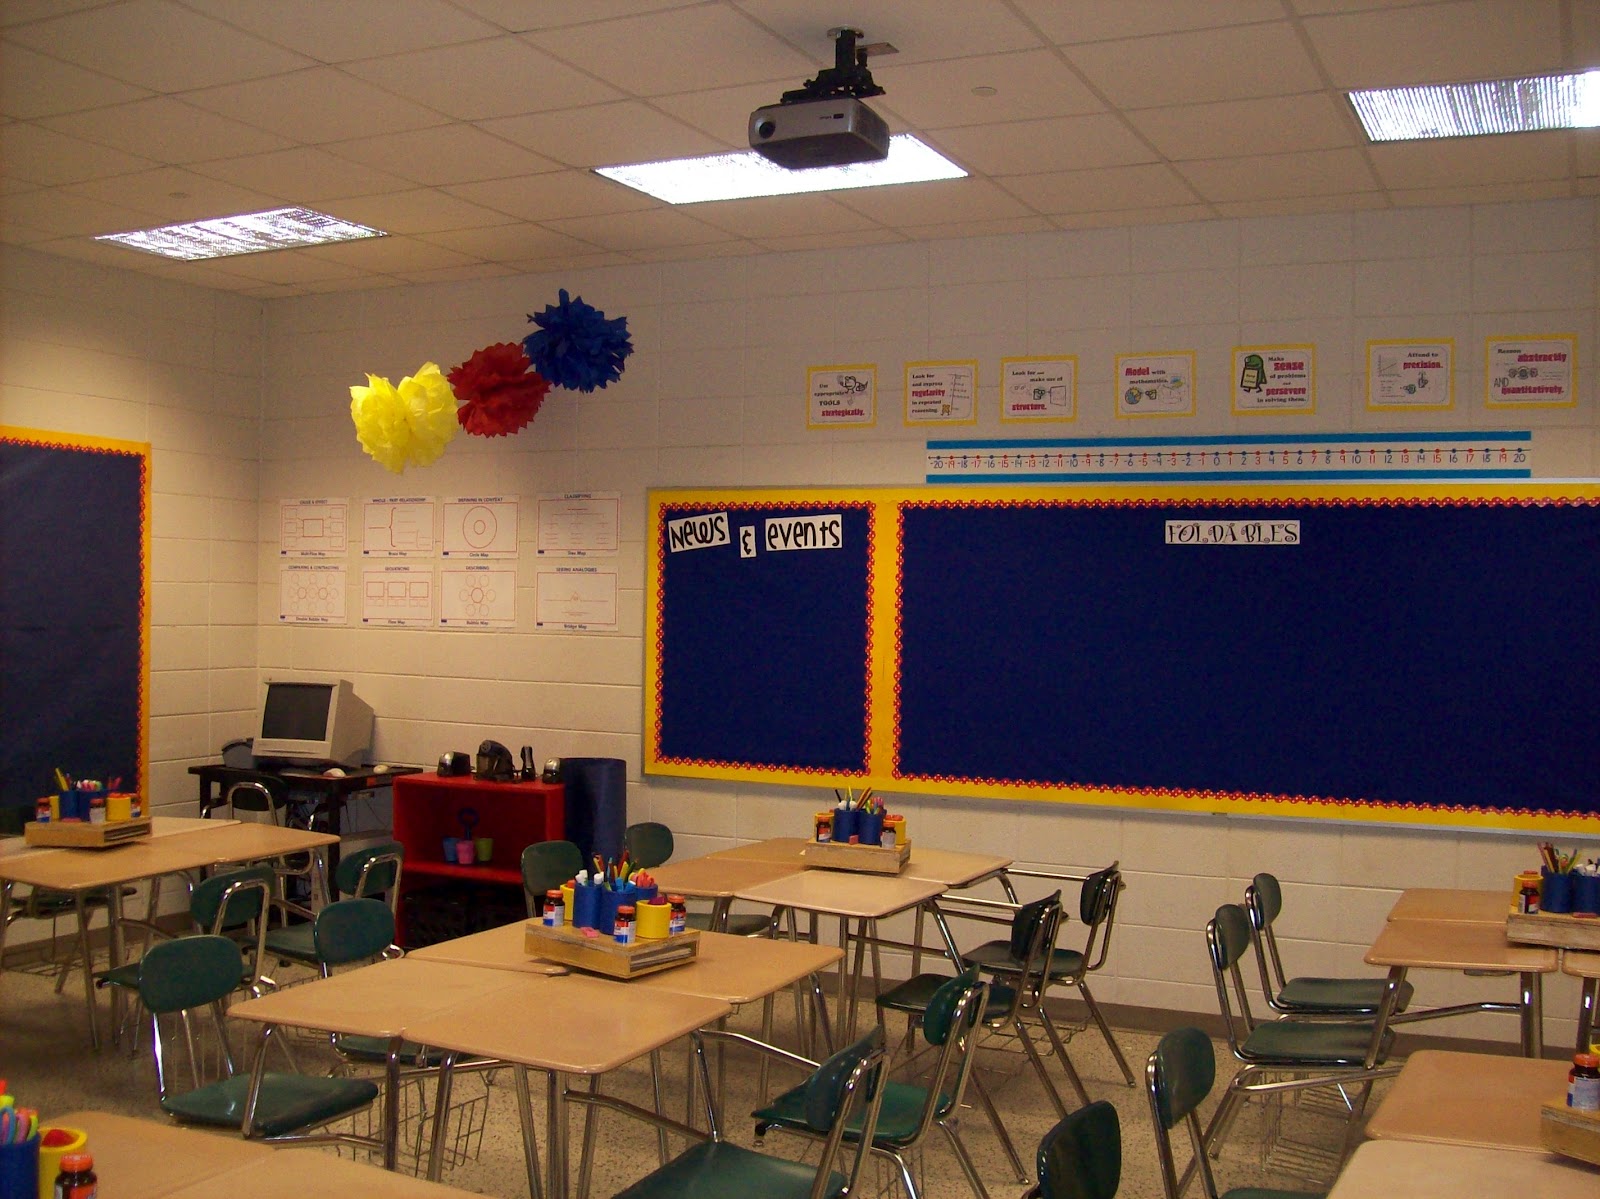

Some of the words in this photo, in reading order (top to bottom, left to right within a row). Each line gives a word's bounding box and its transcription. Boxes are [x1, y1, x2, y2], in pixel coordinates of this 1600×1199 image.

[1517, 352, 1567, 362] abstractly
[1274, 362, 1304, 371] sense
[1403, 360, 1443, 370] precision.
[1125, 367, 1150, 376] Model
[1493, 377, 1509, 387] AND
[911, 389, 946, 397] regularity
[1266, 388, 1306, 396] persevere
[1012, 403, 1047, 411] structure.
[1213, 457, 1221, 466] 0
[1241, 455, 1247, 465] 2
[1255, 455, 1261, 465] 3
[1268, 455, 1275, 465] 4
[1282, 455, 1288, 465] 5
[1296, 454, 1303, 464] 6
[1311, 454, 1317, 464] 7
[1325, 454, 1331, 464] 8
[1339, 454, 1346, 464] 9
[1351, 454, 1362, 464] 10
[1369, 454, 1376, 464] 11
[1384, 454, 1393, 464] 12
[1401, 454, 1410, 464] 13
[1416, 454, 1426, 464] 14
[1433, 454, 1442, 464] 15
[1449, 453, 1458, 463] 16
[1465, 453, 1475, 463] 17
[1482, 453, 1491, 463] 18
[1499, 453, 1507, 463] 19
[1513, 453, 1526, 463] 20
[767, 519, 840, 549] events
[1167, 522, 1298, 543] FOLDABLES
